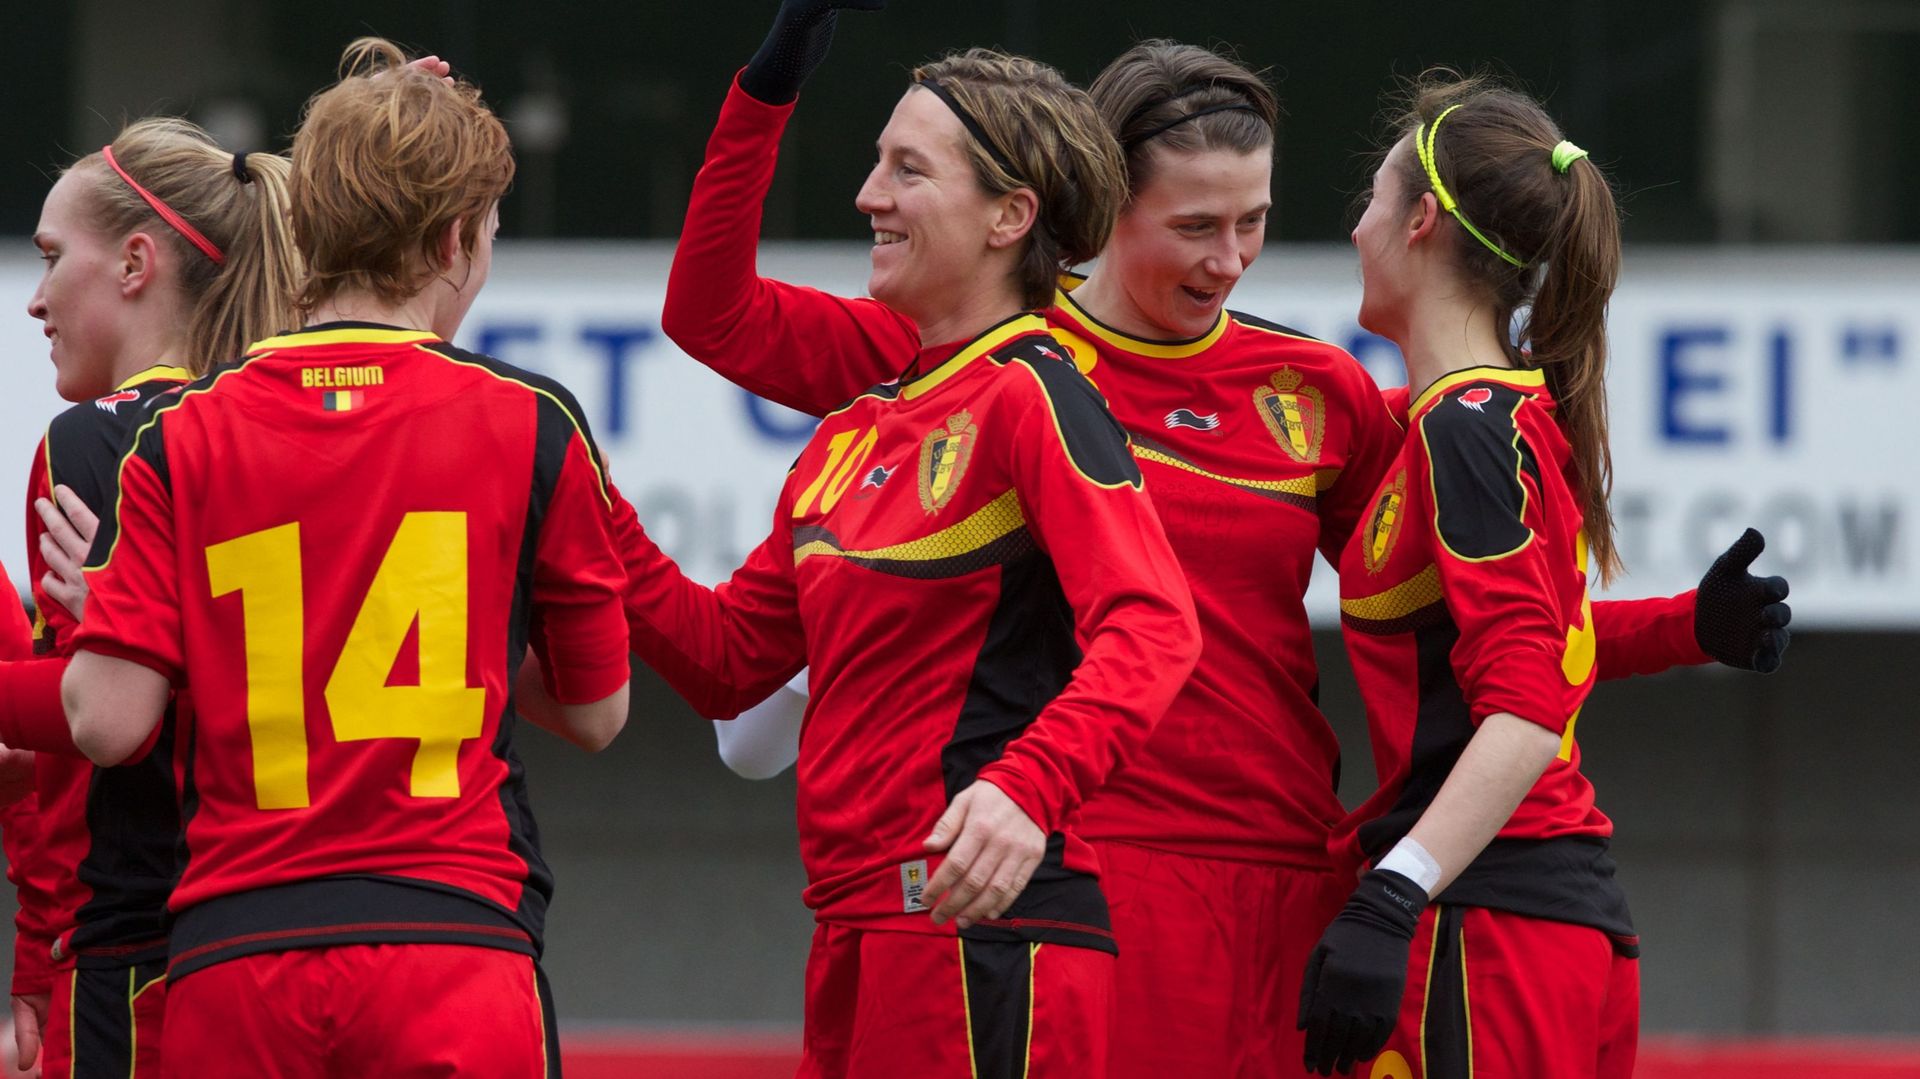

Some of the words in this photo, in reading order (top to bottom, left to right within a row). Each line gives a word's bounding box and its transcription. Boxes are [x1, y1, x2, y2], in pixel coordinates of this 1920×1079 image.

[302, 366, 384, 388] BELGIUM
[792, 425, 878, 518] 10
[205, 511, 486, 810] 14
